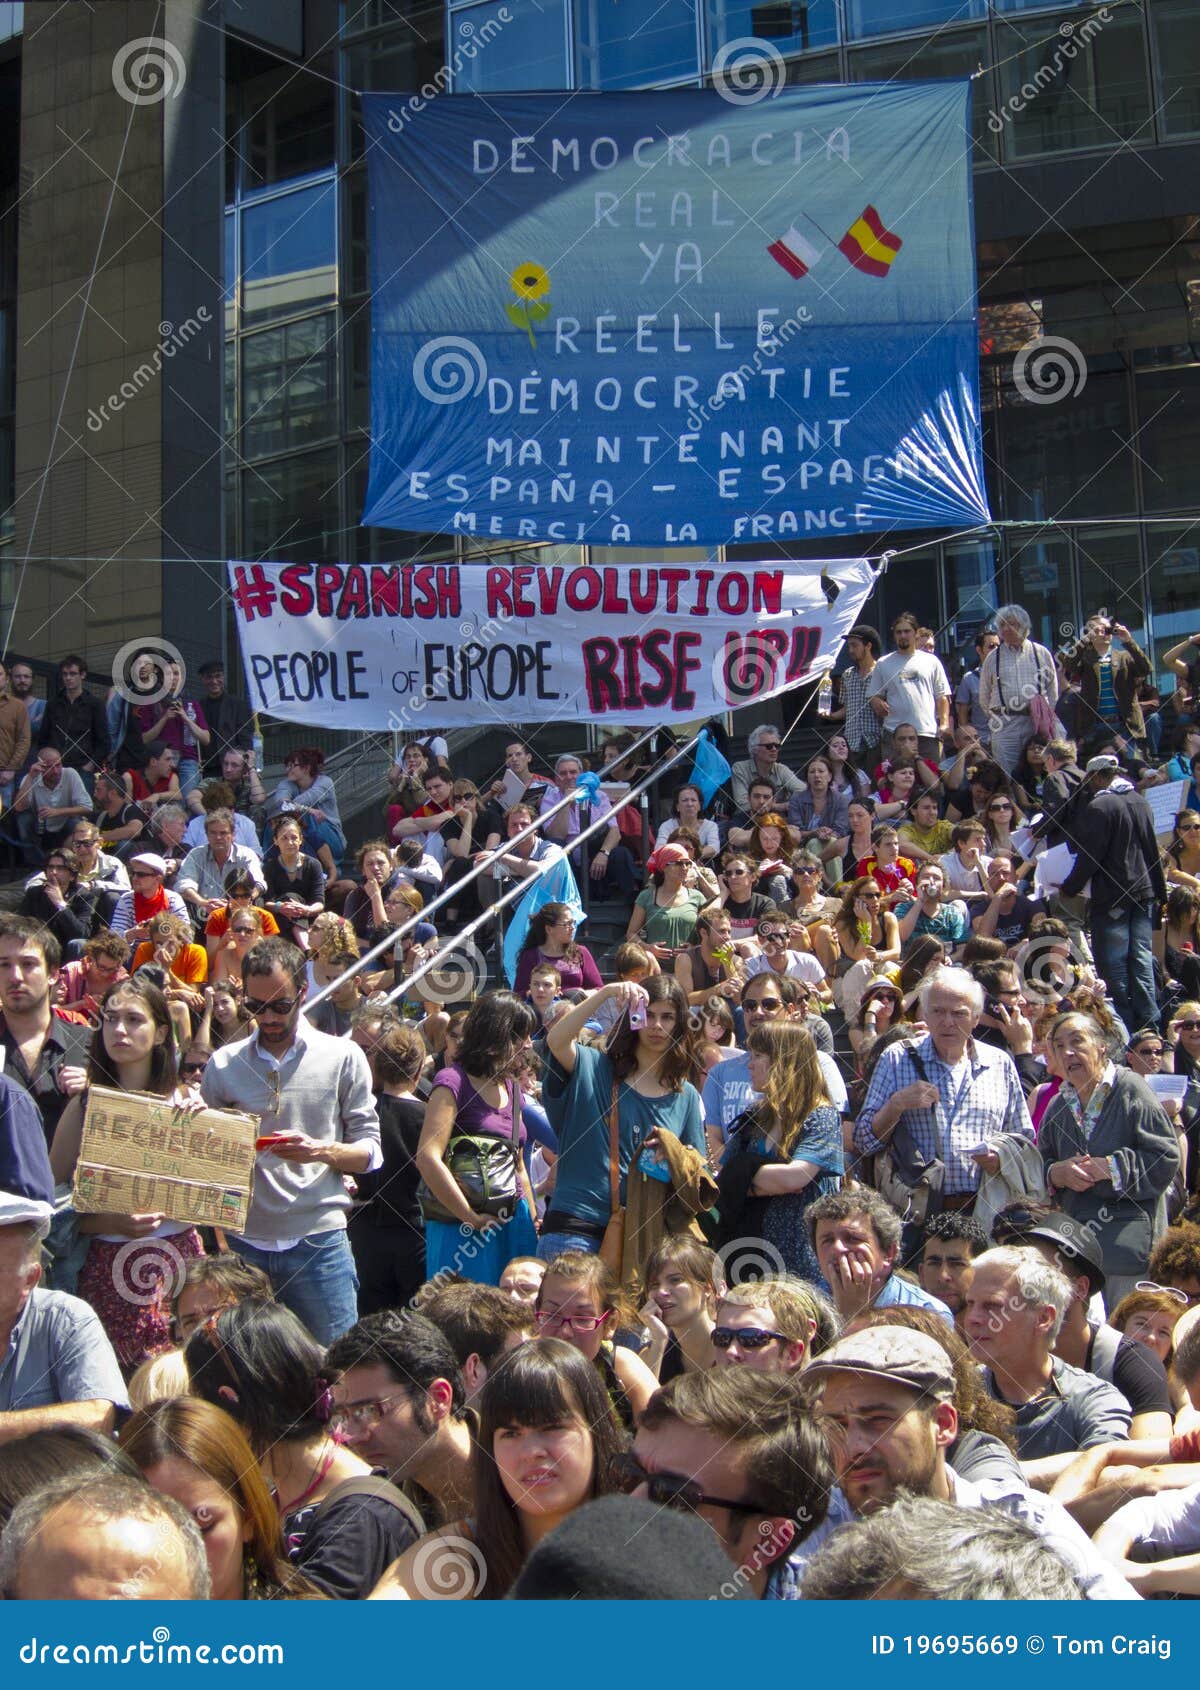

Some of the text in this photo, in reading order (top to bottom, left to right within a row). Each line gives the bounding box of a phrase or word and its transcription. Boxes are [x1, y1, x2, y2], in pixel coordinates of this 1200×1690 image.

[473, 127, 851, 174] DEMOCRACIA
[594, 189, 735, 228] REAL
[637, 242, 703, 284] YA
[555, 307, 780, 354] RÉELLE
[487, 366, 850, 415] DÉMOCRATIE
[485, 418, 850, 467] MAINTENANT
[409, 466, 614, 506] ESPAÑA
[453, 511, 586, 541] MERCI
[665, 522, 698, 542] LA
[734, 503, 873, 538] FRANCE
[486, 565, 784, 618] REVOLUTION
[250, 651, 369, 709] PEOPLE
[391, 671, 420, 694] OF
[582, 627, 702, 714] RISE
